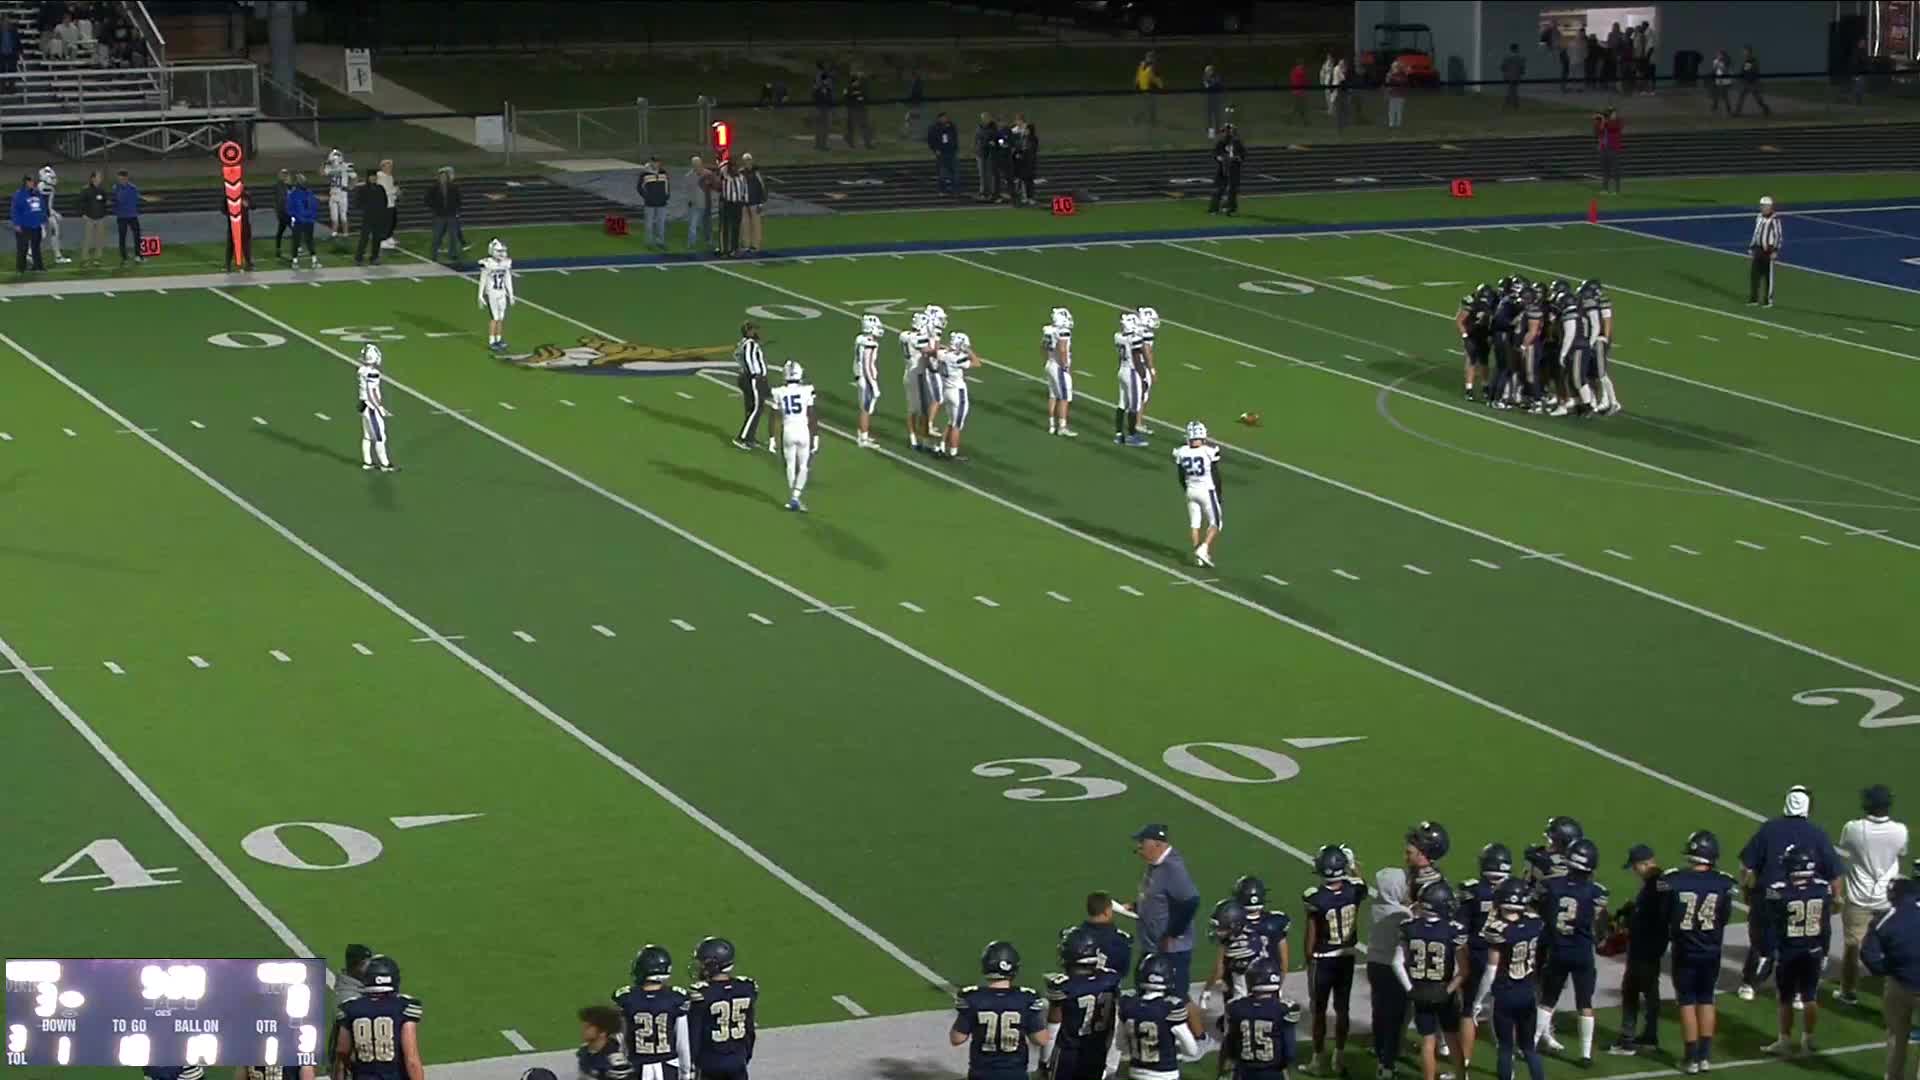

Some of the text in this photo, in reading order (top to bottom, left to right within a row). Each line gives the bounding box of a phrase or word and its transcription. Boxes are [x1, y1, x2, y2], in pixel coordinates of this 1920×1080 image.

[716, 125, 727, 146] 1
[1054, 197, 1073, 213] 10
[140, 239, 159, 253] 30
[782, 394, 802, 415] 15
[1181, 456, 1206, 477] 23
[971, 742, 1300, 801] 30
[40, 821, 383, 892] 40
[1556, 896, 1578, 936] 2
[1678, 891, 1718, 931] 74
[1409, 938, 1446, 981] 33
[352, 1016, 395, 1063] 88
[634, 1012, 671, 1054] 21
[710, 997, 752, 1042] 35
[977, 1010, 1021, 1053] 76
[1239, 1018, 1275, 1063] 15
[1126, 1019, 1160, 1063] 12
